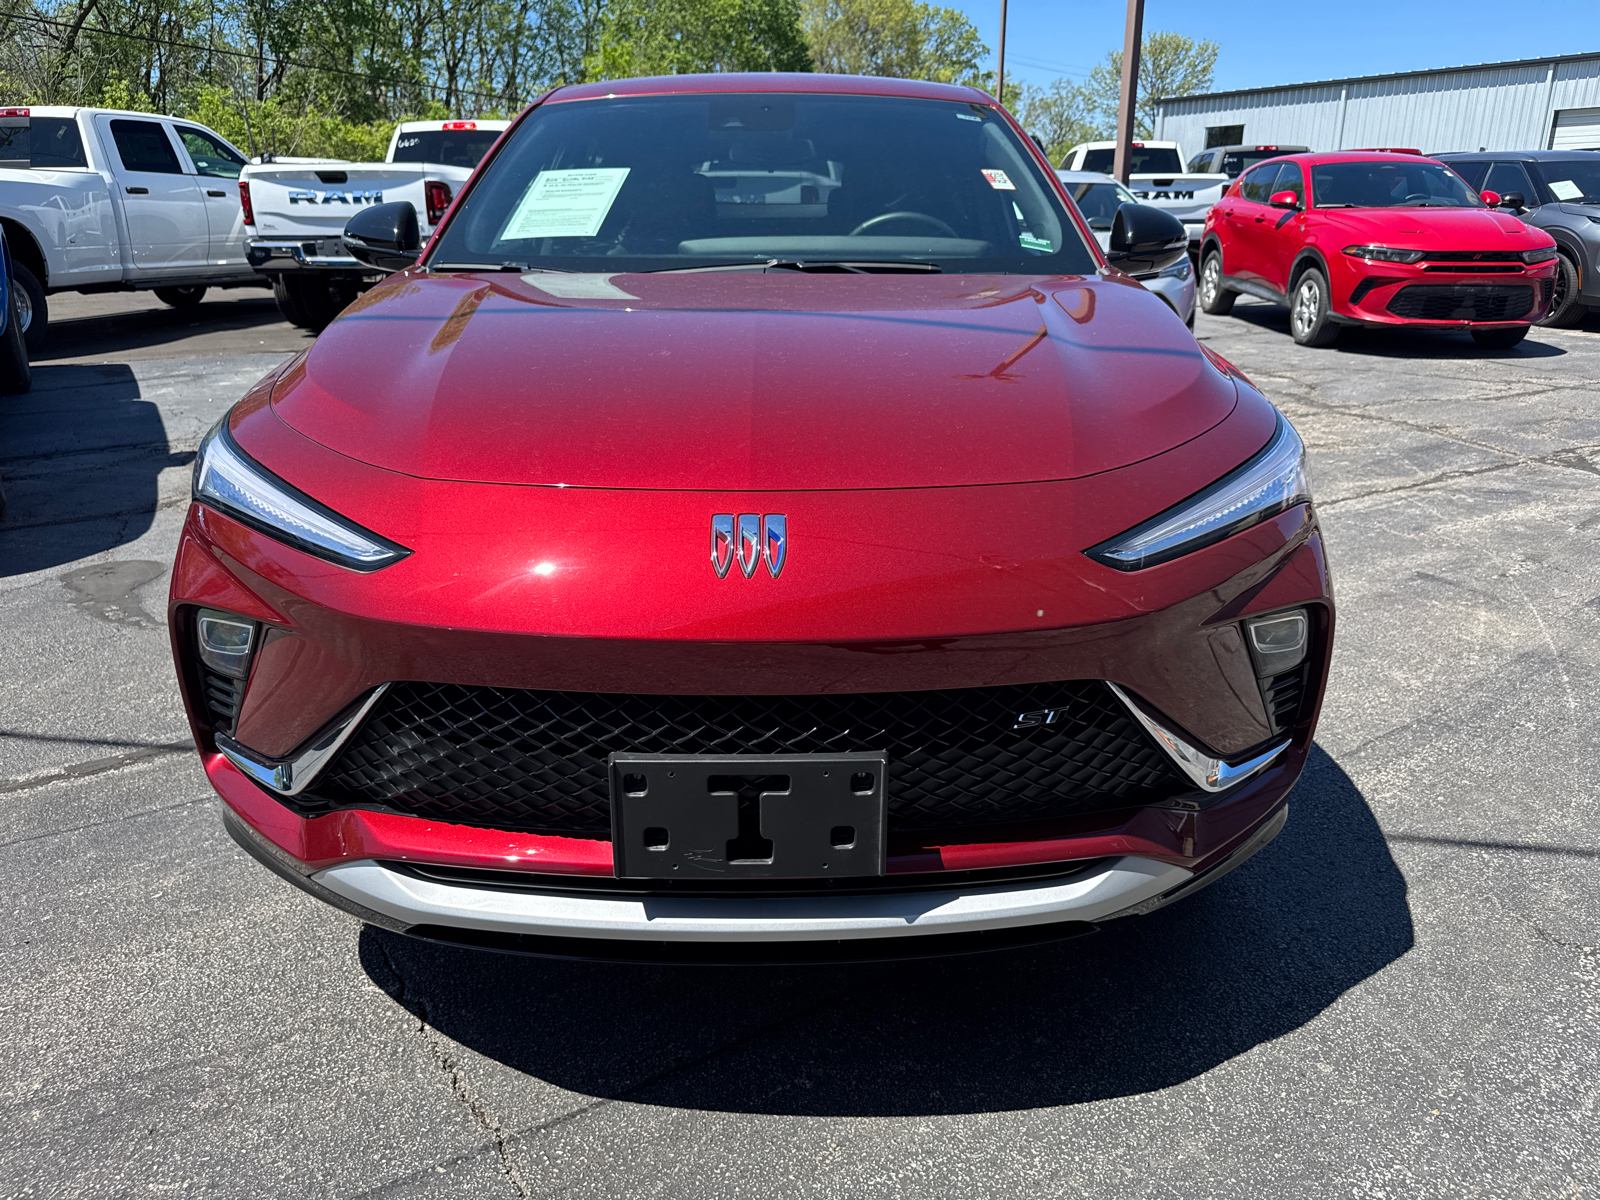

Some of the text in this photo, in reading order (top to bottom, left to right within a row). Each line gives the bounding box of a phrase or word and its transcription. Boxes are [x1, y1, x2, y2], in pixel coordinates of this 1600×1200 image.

[288, 189, 384, 205] RAM
[1131, 190, 1194, 200] RAM
[1013, 705, 1069, 729] ST
